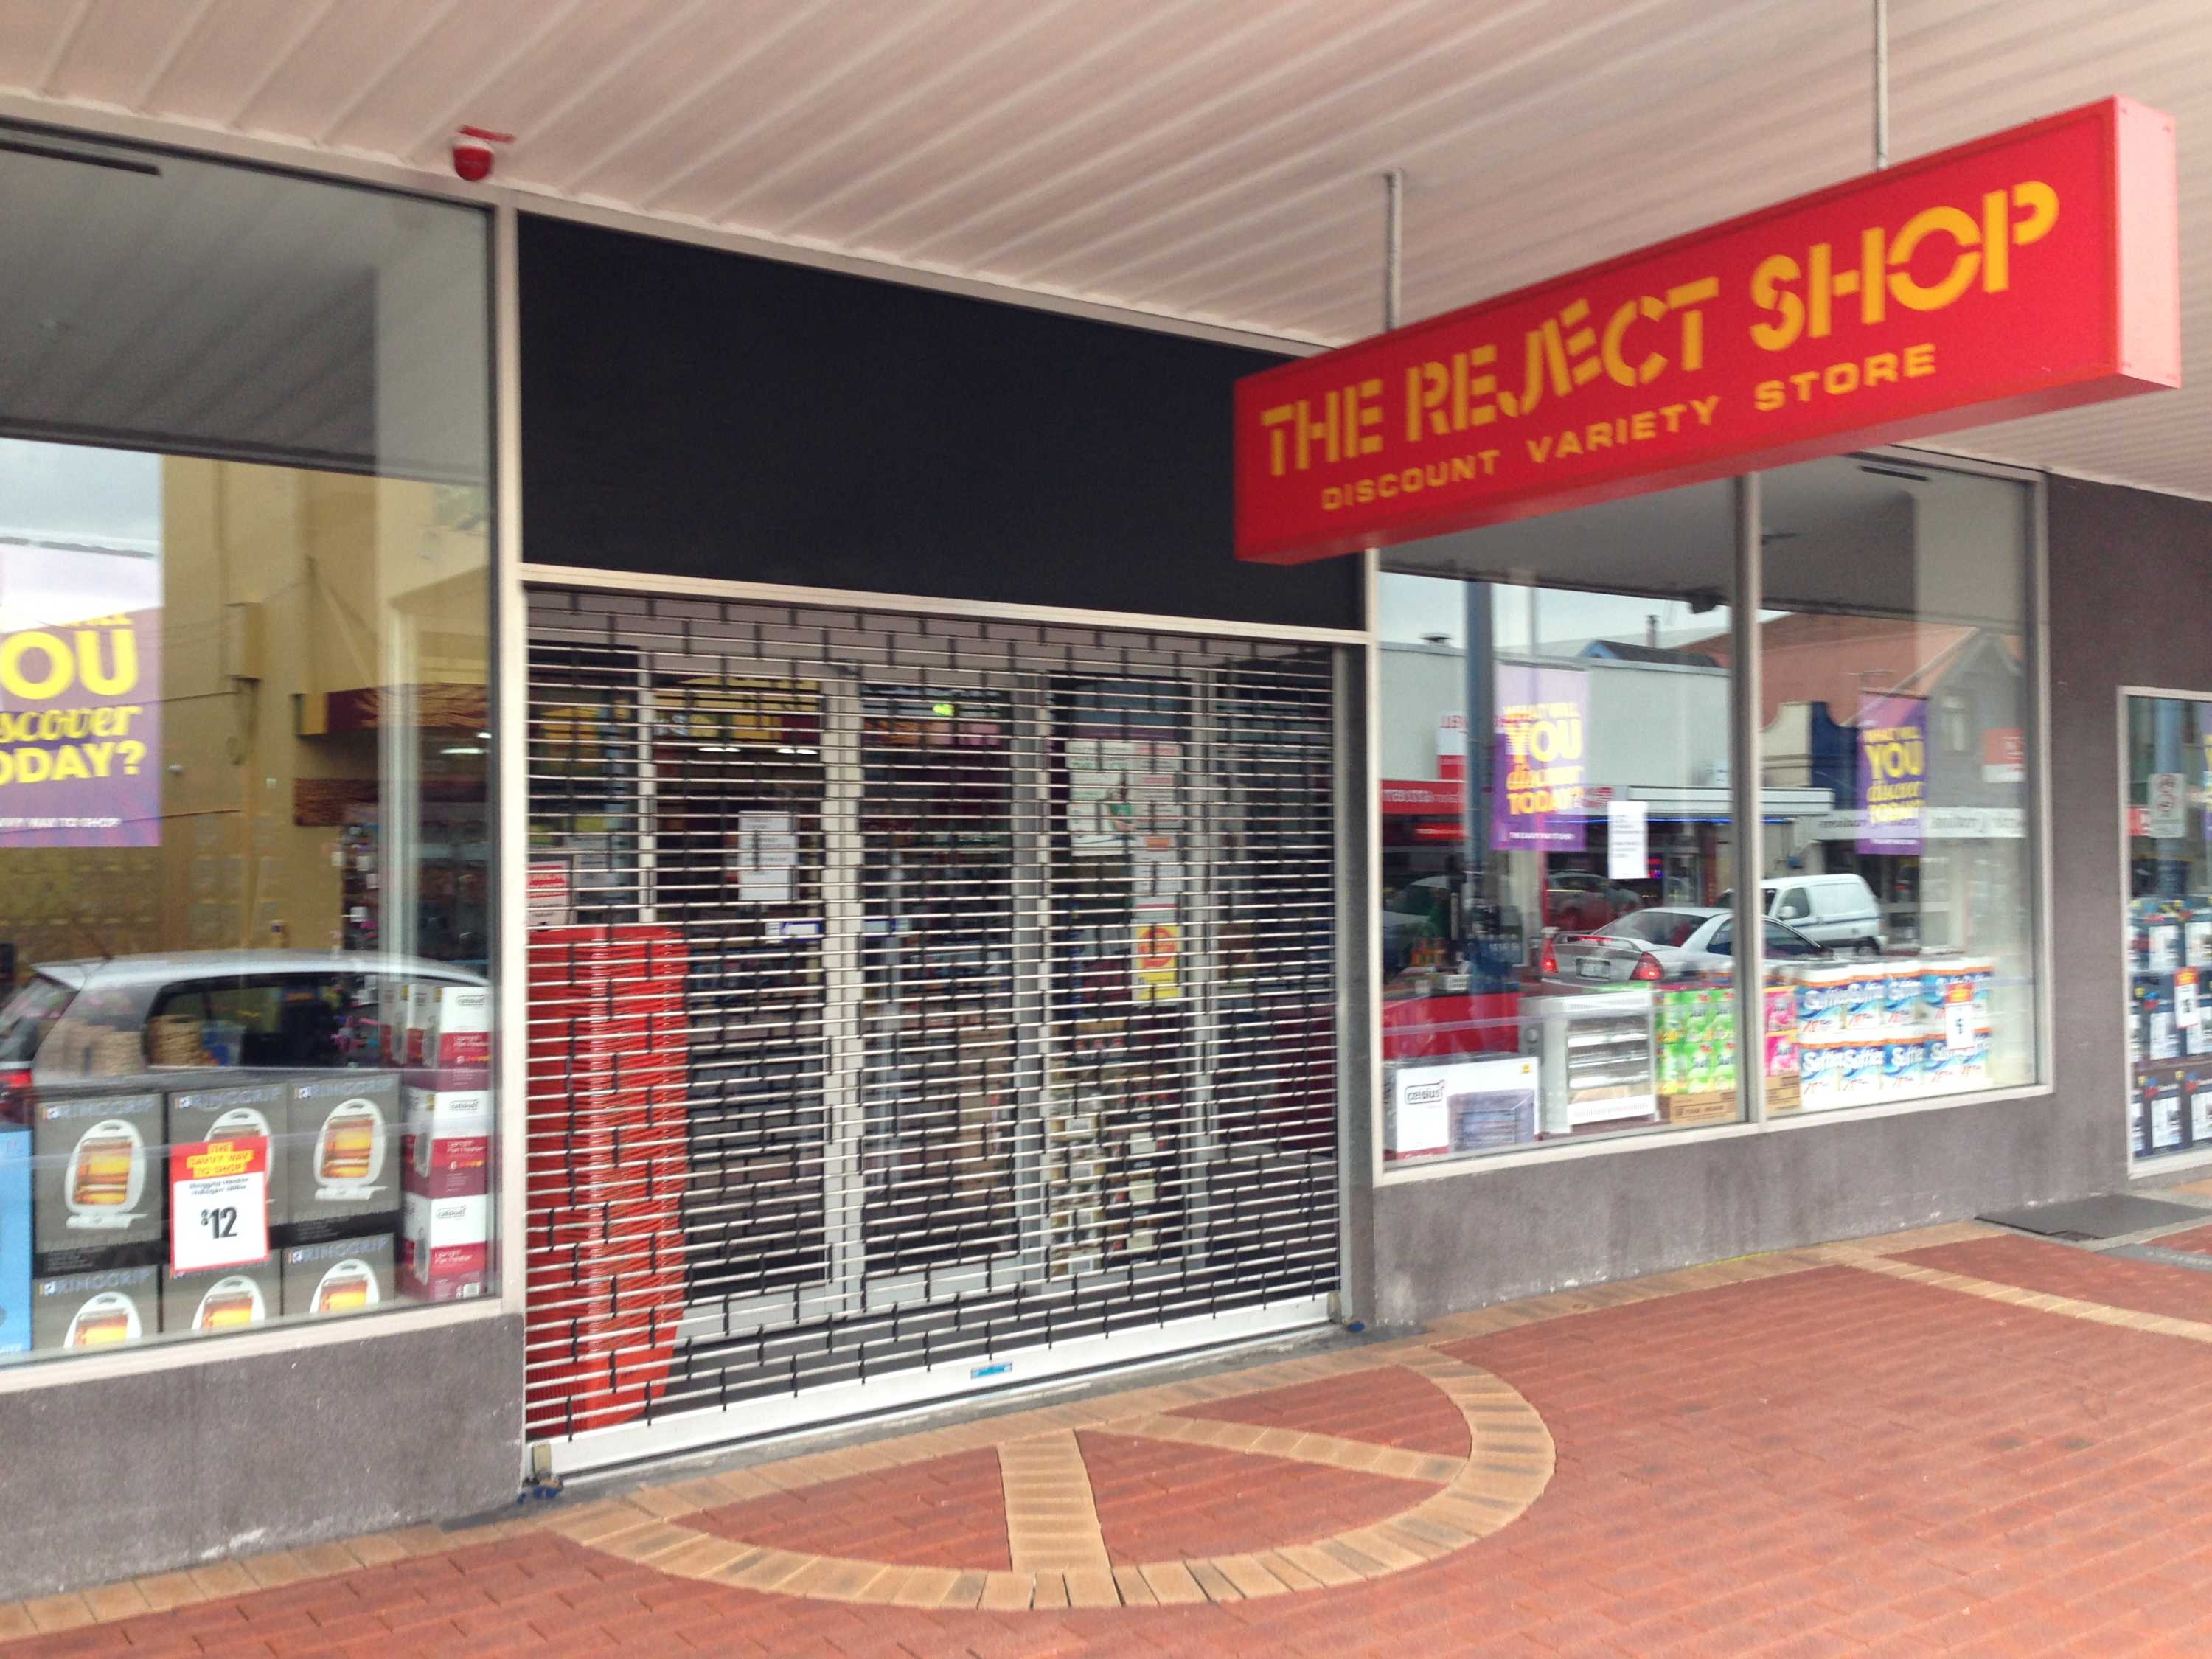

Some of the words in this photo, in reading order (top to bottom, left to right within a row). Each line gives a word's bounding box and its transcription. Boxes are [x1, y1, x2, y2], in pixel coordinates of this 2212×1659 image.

[1261, 378, 1383, 477] THE
[1405, 276, 1719, 442] REJECT
[1750, 179, 2061, 353] SHOP
[1321, 449, 1500, 511] DISCOUNT
[1527, 396, 1720, 463] VARIETY
[1755, 343, 1937, 411] STORE
[1505, 719, 1582, 763] YOU
[1863, 740, 1924, 779] YOU
[201, 1206, 239, 1240] $12
